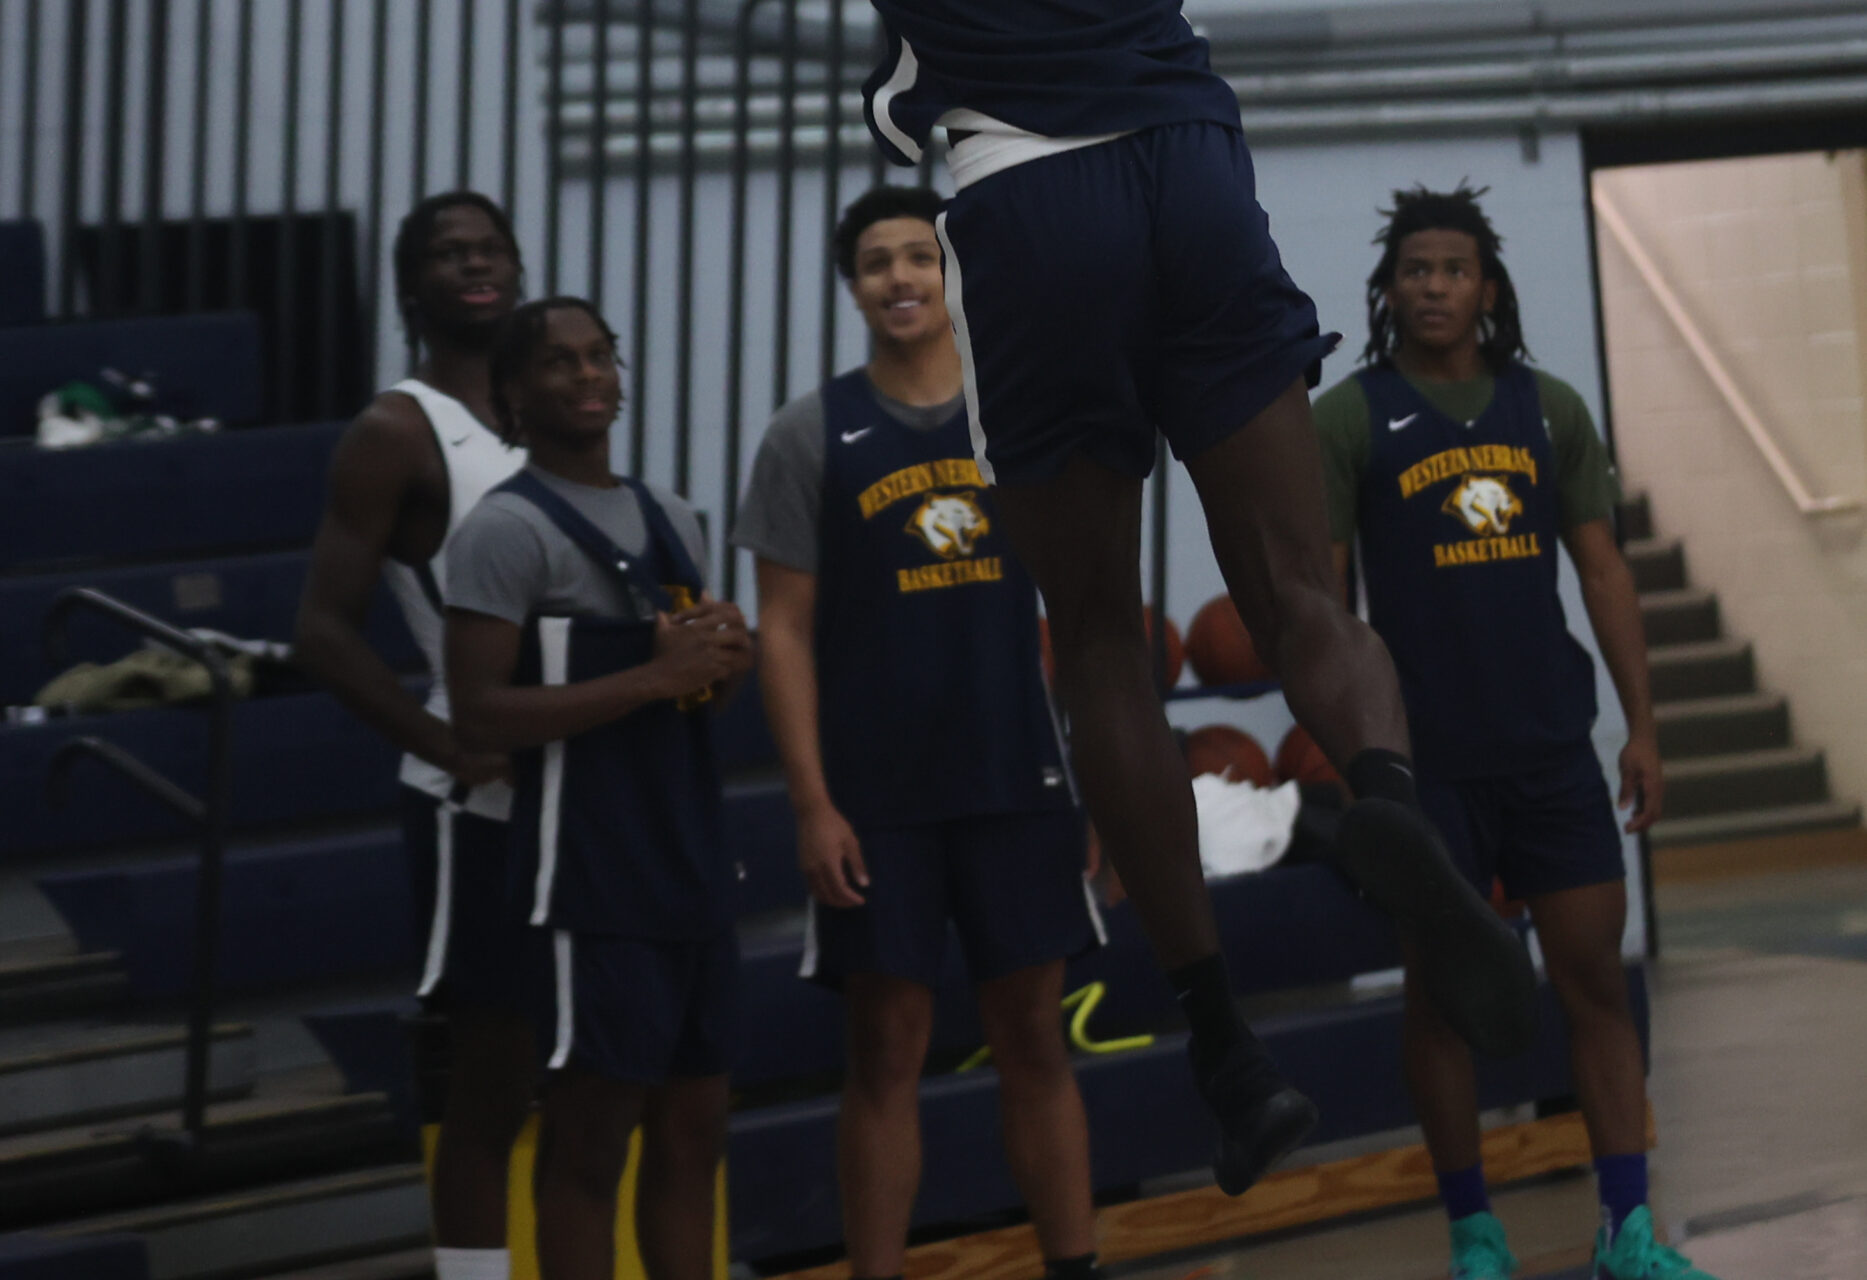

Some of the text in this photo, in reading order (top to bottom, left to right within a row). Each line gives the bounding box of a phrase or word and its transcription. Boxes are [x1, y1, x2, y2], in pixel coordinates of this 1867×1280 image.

[1398, 447, 1470, 499] WESTERN
[1434, 533, 1541, 567] BASKETBALL
[897, 556, 1002, 592] BASKETBALL
